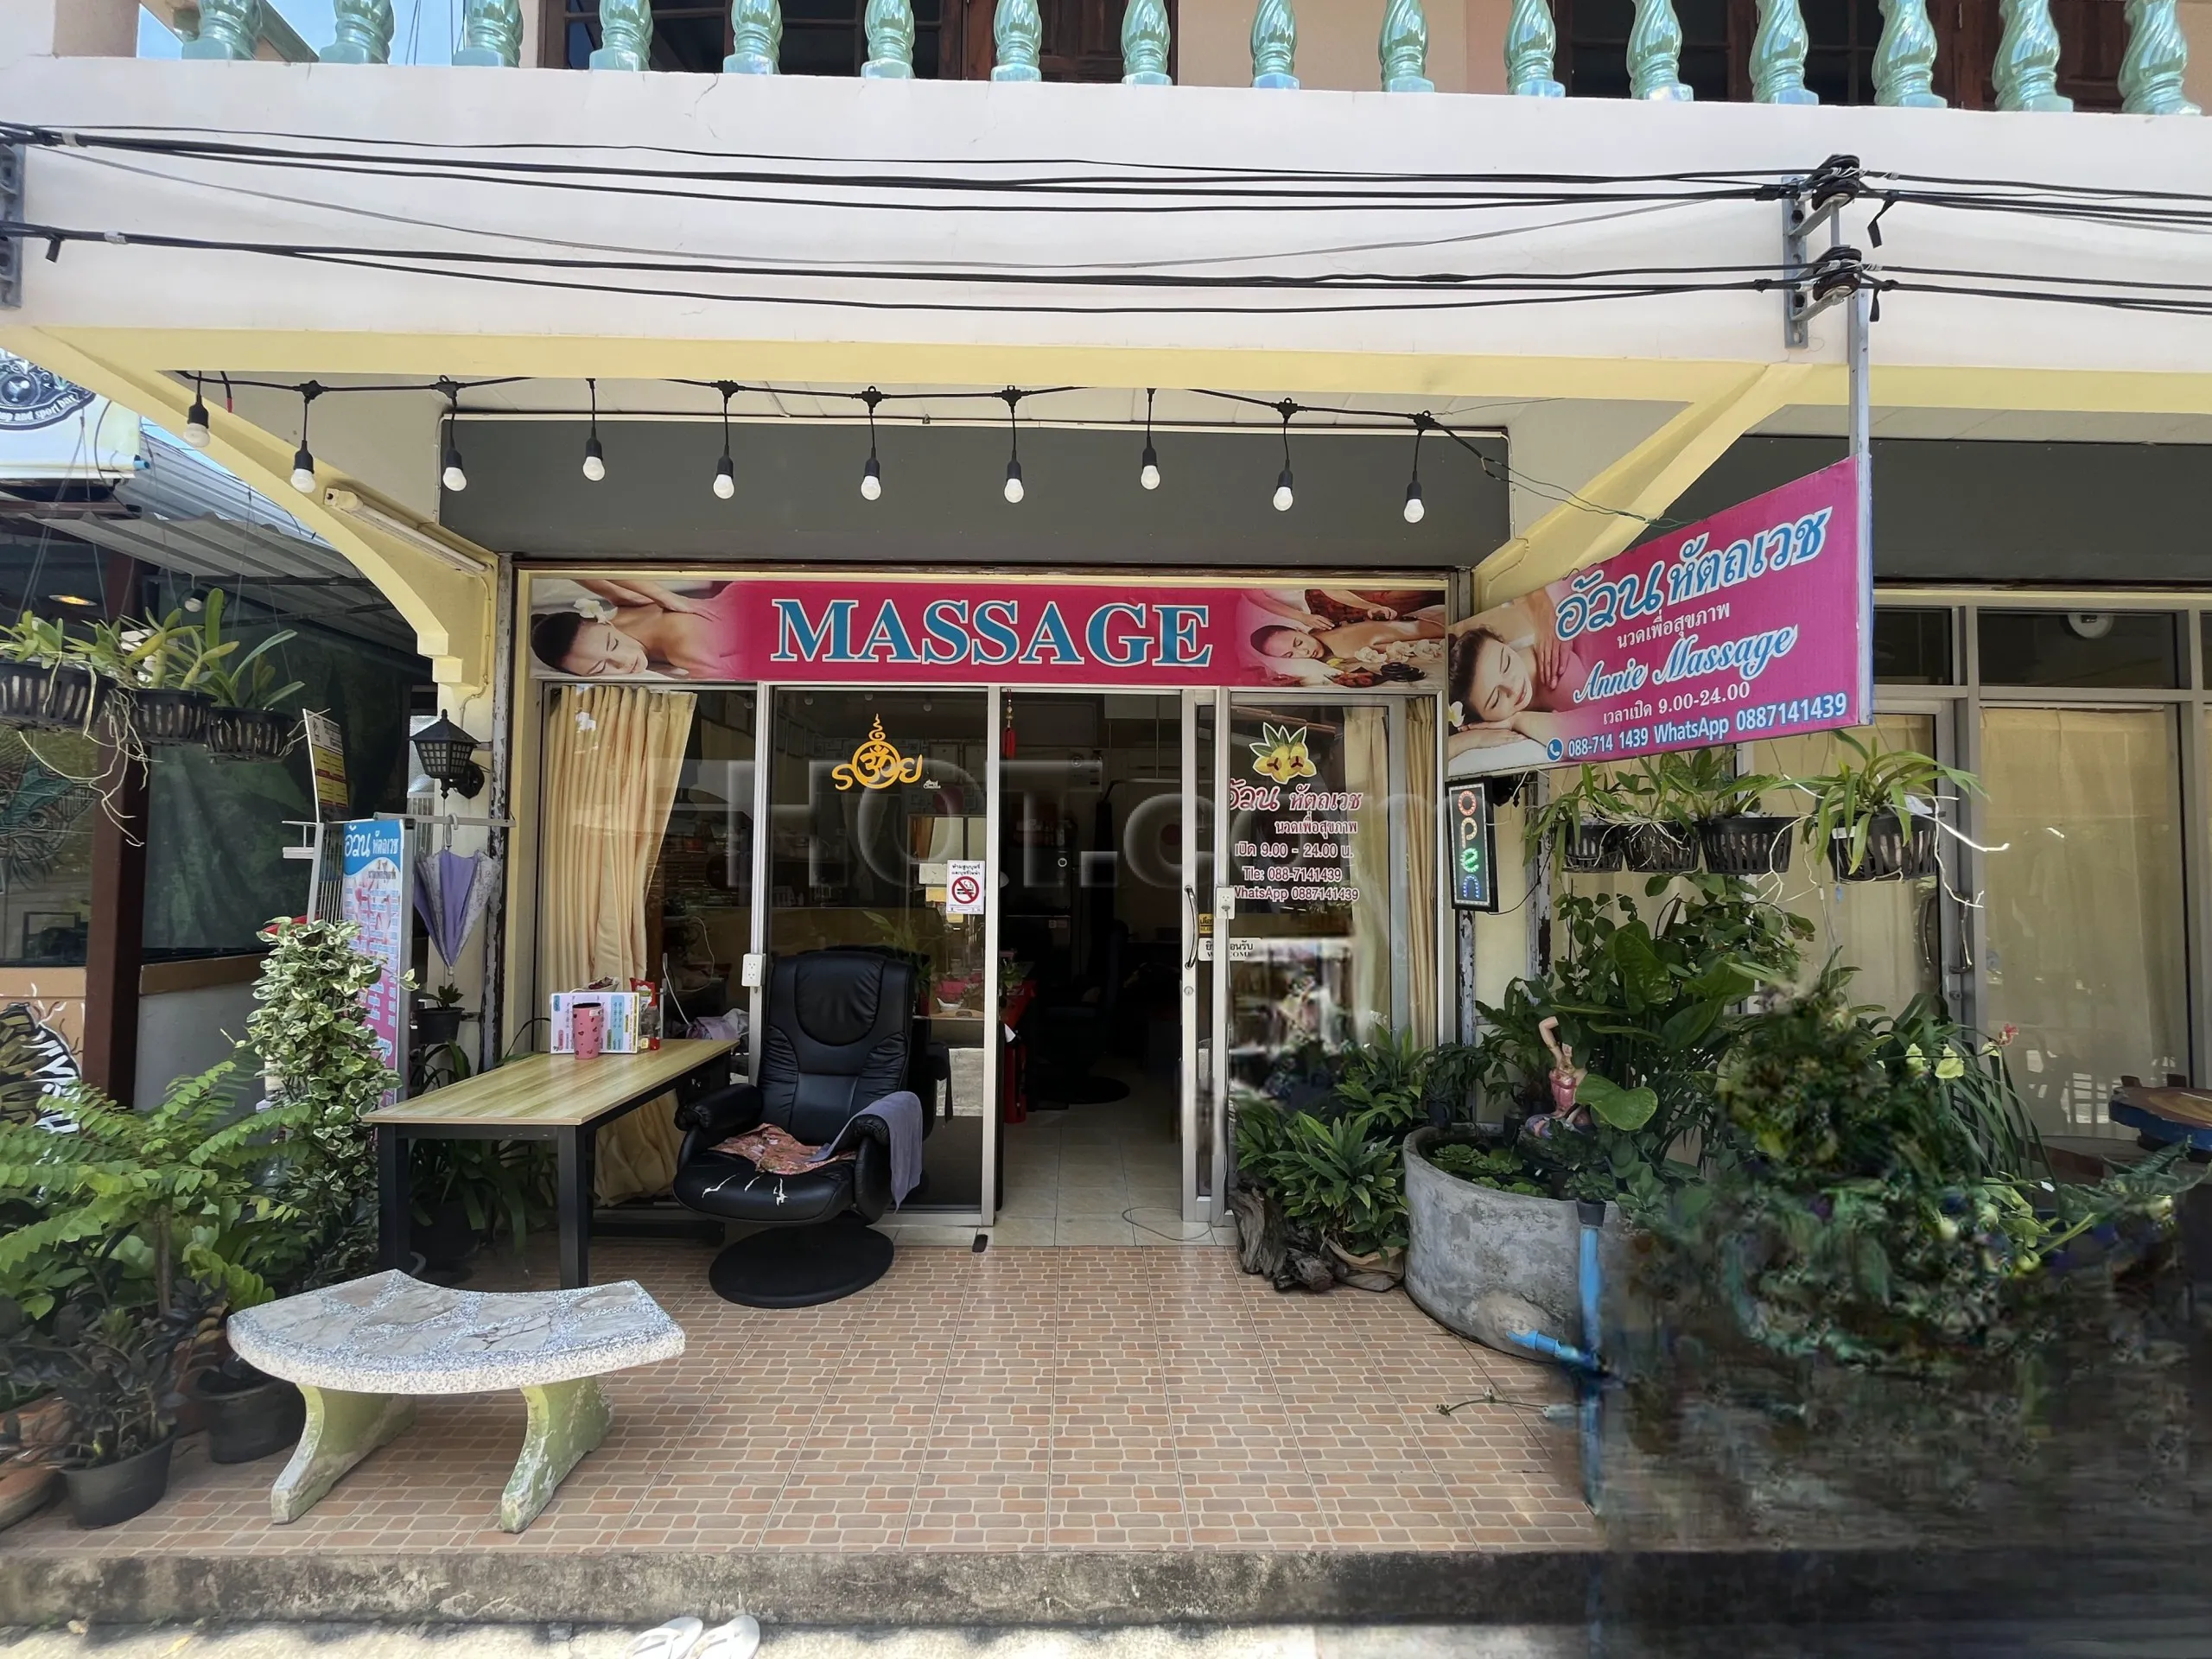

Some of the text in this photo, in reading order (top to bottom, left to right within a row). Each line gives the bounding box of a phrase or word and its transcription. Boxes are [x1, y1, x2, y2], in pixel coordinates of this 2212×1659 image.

[1555, 506, 1833, 641] อ้วน หัตถเวช
[770, 598, 1213, 668] MASSAGE
[1618, 602, 1731, 649] นวดเพื่อสุขภาพ
[1573, 624, 1798, 703] Annie Massage
[1567, 693, 1847, 757] 088-714 1439 WhatsApp 0887141439
[1603, 682, 1751, 725] เวลาเปิด 9.00-24.00
[1289, 784, 1363, 810] หัตถเวช
[1274, 811, 1358, 840] นวดเพื่อสุขภาพ
[1235, 841, 1257, 856] เปิด
[1260, 843, 1288, 858] 9.00
[1303, 843, 1338, 858] 24.00
[1235, 886, 1359, 901] WhatsApp 0887141439
[1242, 866, 1342, 882] Tle: 088-7141439
